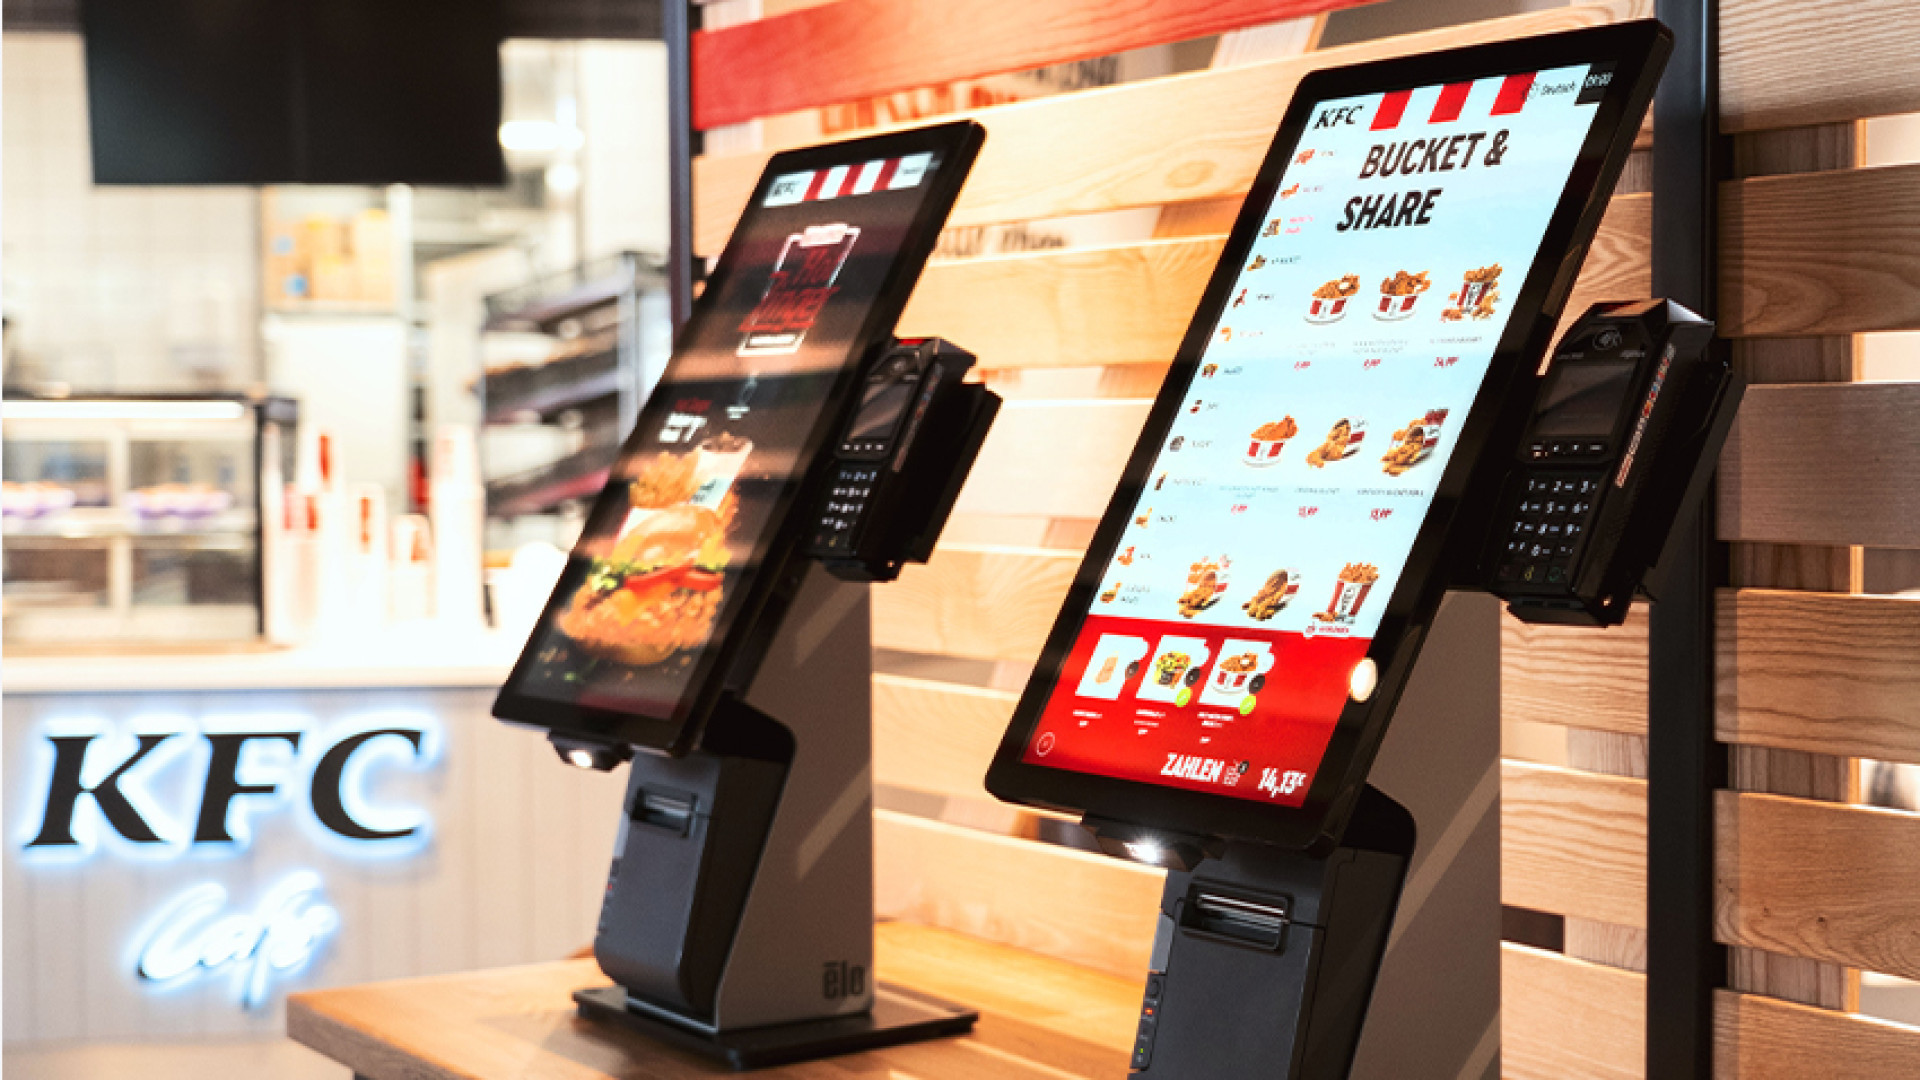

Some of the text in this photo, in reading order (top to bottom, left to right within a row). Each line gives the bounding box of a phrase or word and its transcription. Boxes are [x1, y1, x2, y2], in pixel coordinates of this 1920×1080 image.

[1313, 104, 1366, 130] KFC
[1358, 128, 1510, 179] BUCKET &
[1335, 187, 1444, 232] SHARE
[23, 728, 427, 849] KFC
[1160, 752, 1225, 783] ZAHLEN
